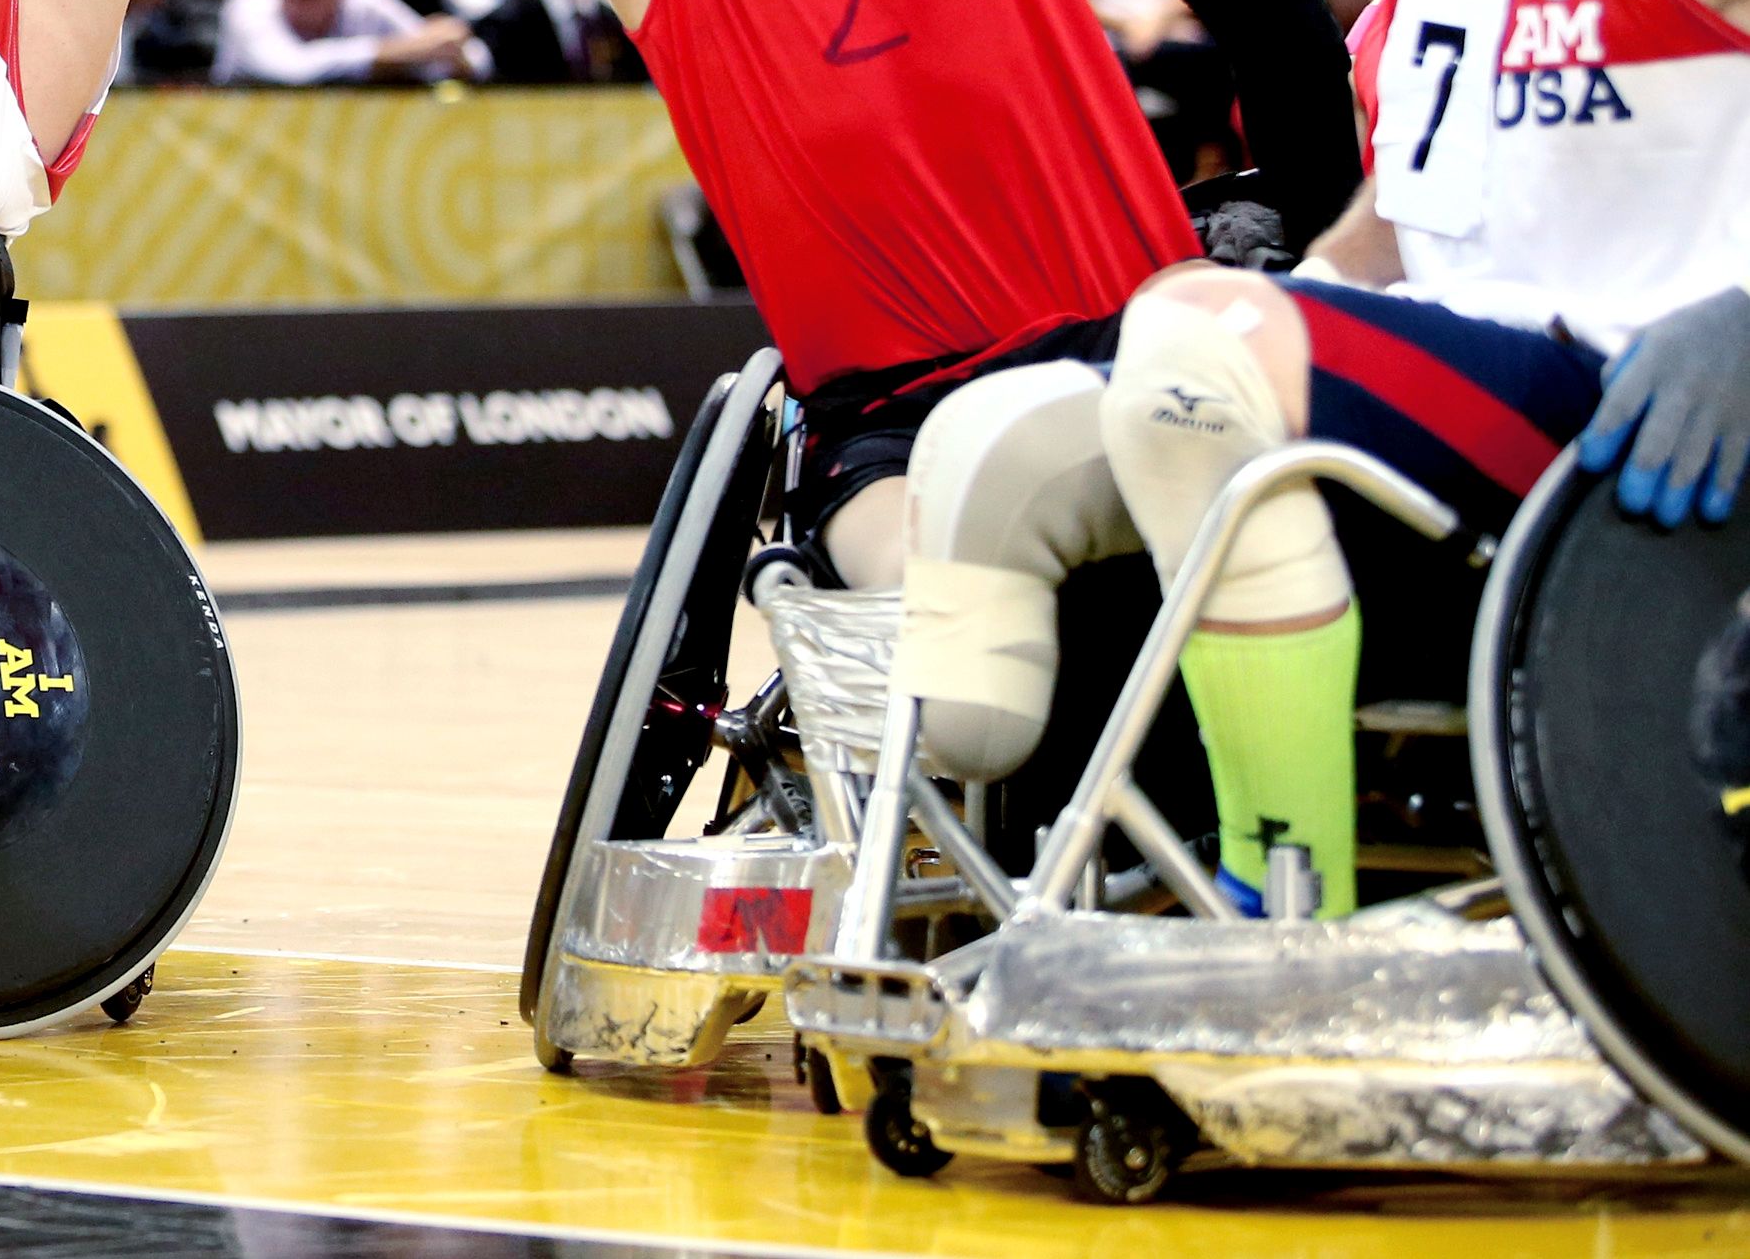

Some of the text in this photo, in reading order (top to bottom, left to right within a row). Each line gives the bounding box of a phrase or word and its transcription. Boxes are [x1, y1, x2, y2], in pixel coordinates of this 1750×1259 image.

[1502, 2, 1605, 67] AM
[1412, 21, 1466, 172] 7
[1494, 68, 1632, 128] USA
[213, 386, 674, 453] MAYOR OF LONDON
[188, 575, 224, 649] KENDA
[38, 674, 75, 692] I
